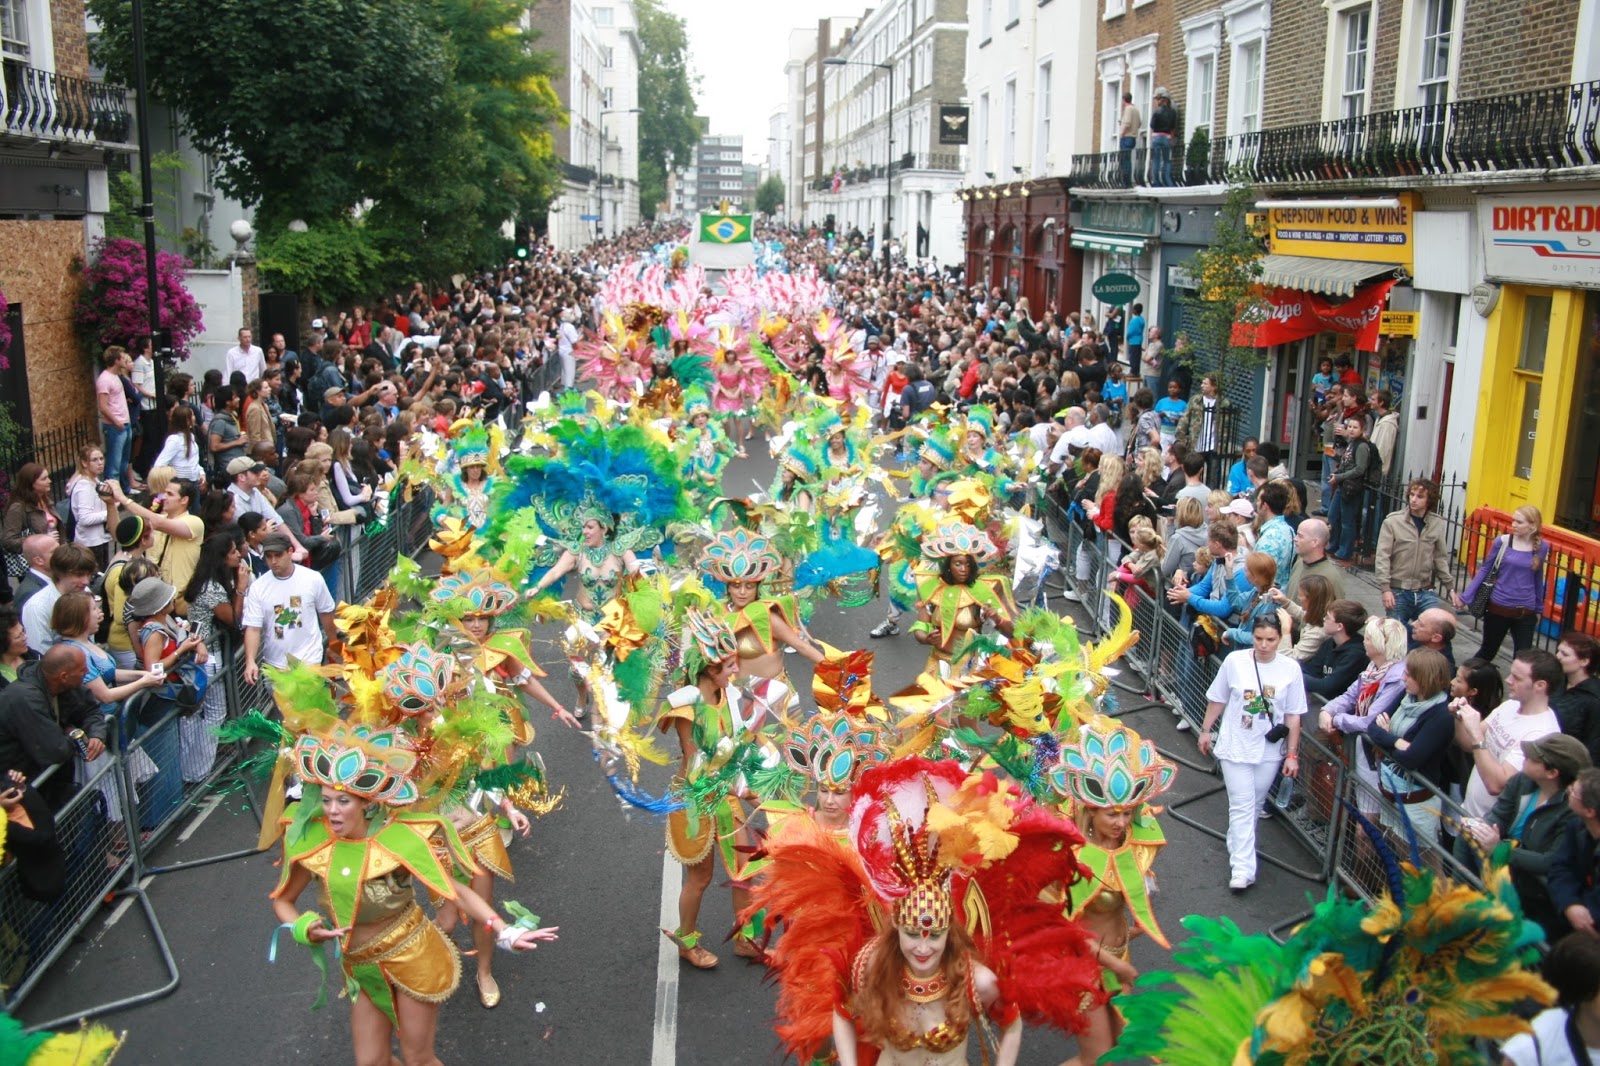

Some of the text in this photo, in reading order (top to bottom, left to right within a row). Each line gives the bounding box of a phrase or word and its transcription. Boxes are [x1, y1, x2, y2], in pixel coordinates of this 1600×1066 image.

[1274, 207, 1324, 224] CHEPSTOW
[1328, 208, 1355, 225] FOOD
[1361, 208, 1370, 225] &
[1375, 206, 1407, 226] WINE
[1277, 230, 1288, 239] FOOD
[1292, 231, 1302, 239] WINE
[1326, 232, 1335, 241] ATM
[1340, 233, 1359, 242] PAYPOINT
[1365, 233, 1384, 242] LOTTERY
[1388, 234, 1403, 243] NEWS
[1094, 284, 1138, 293] LA BOUTIKA
